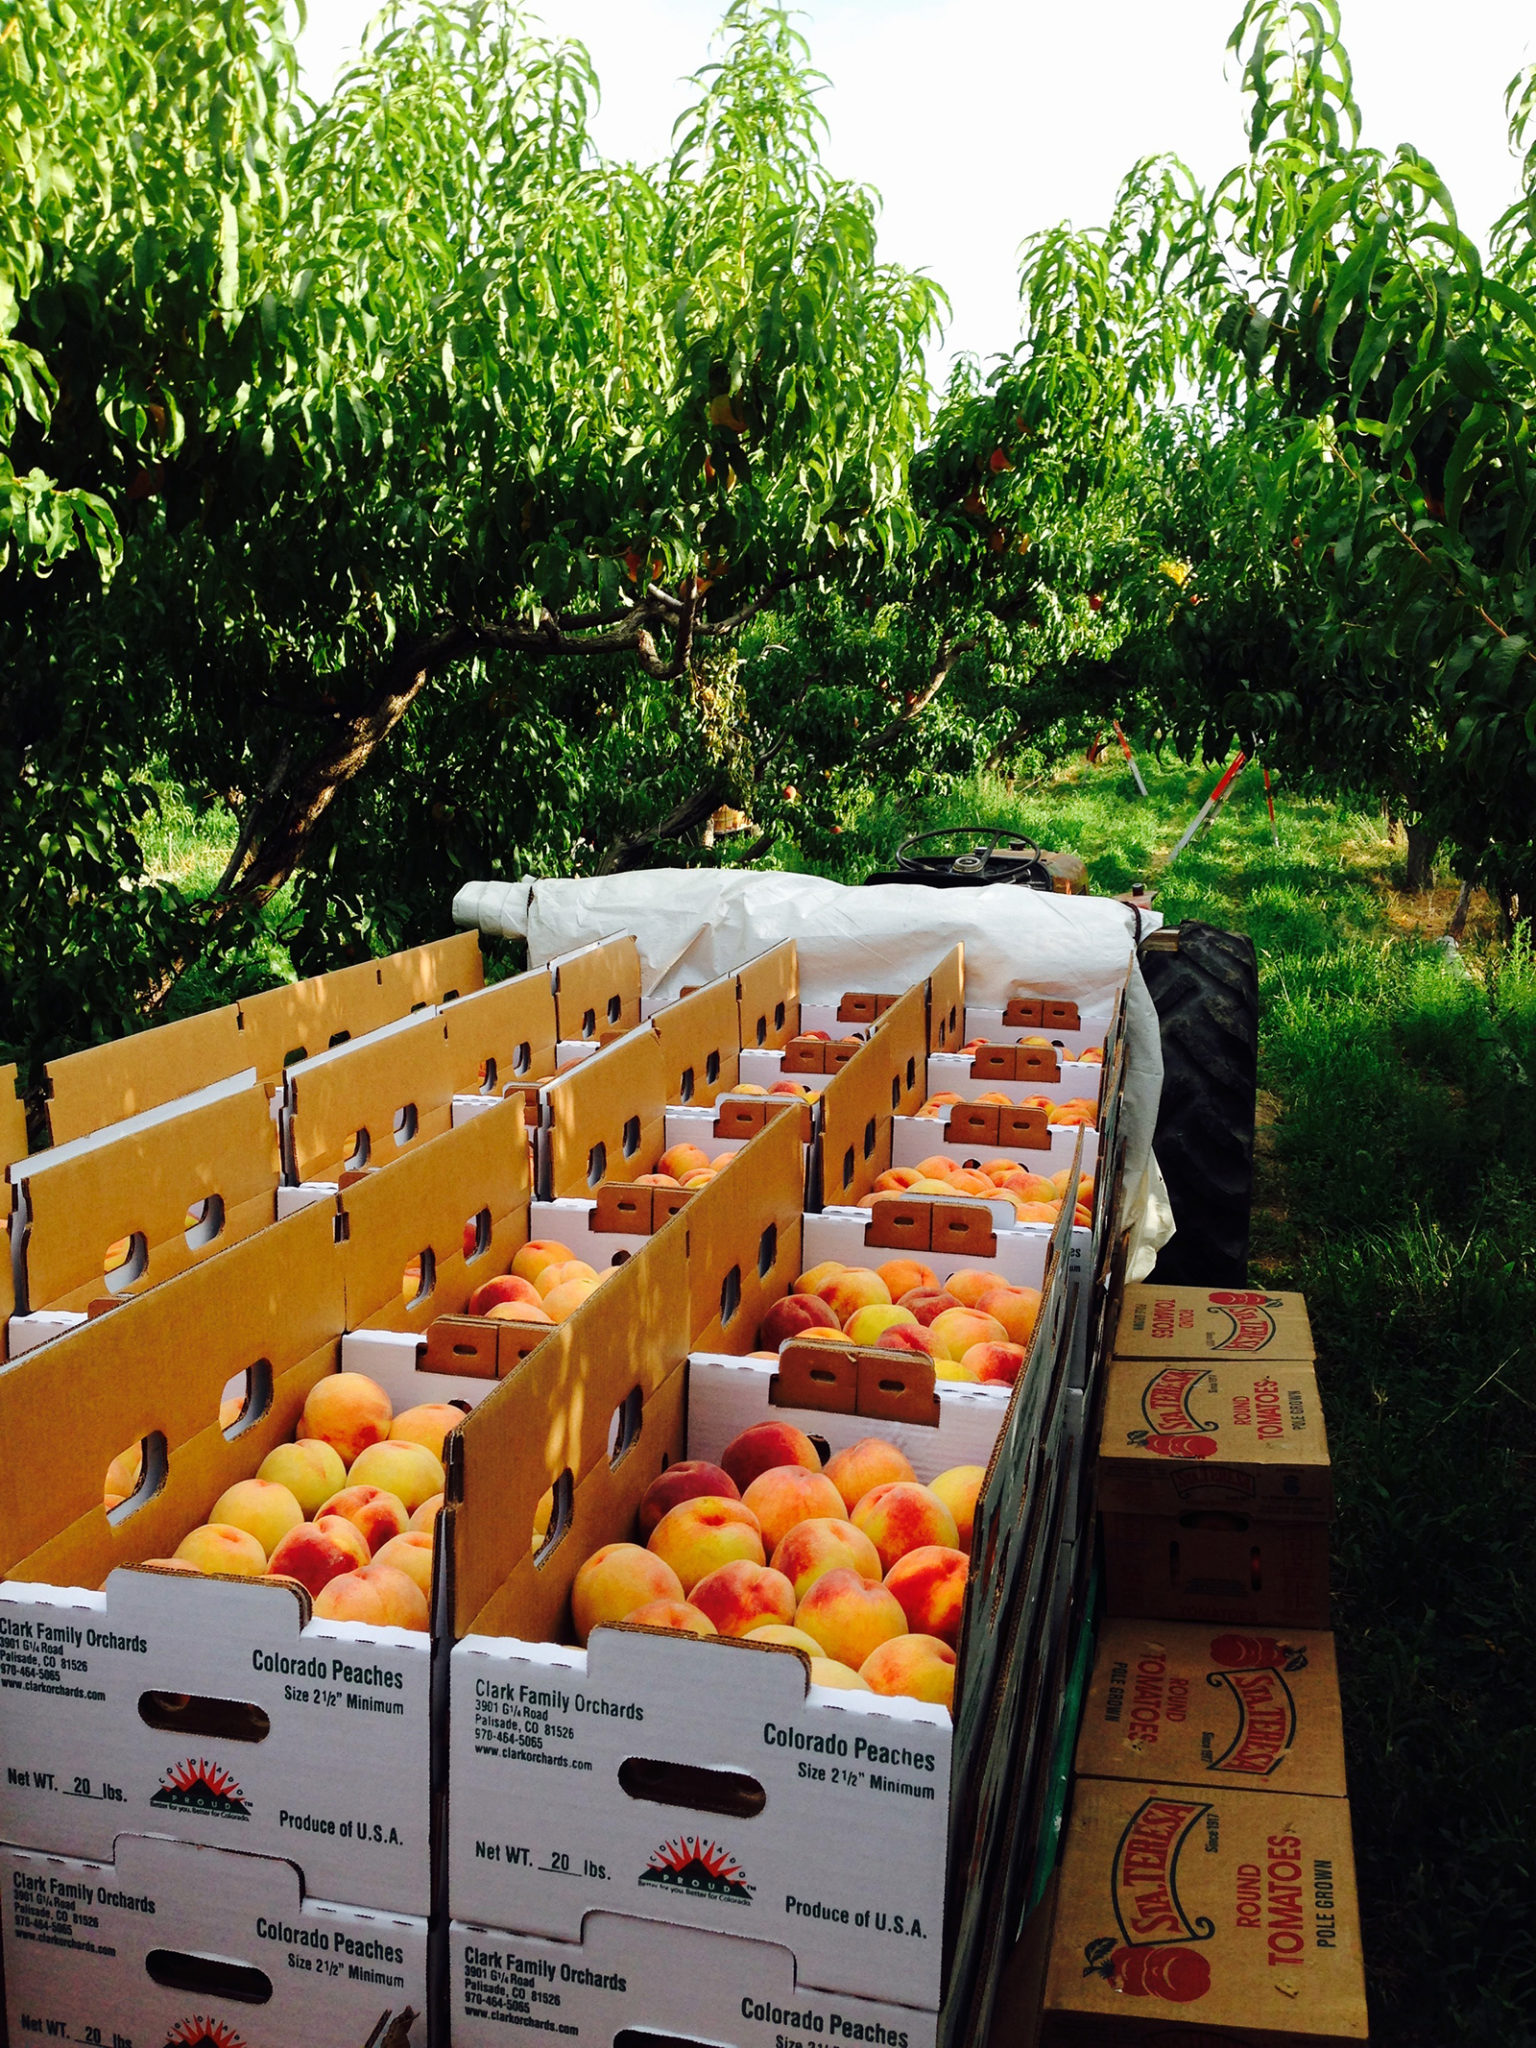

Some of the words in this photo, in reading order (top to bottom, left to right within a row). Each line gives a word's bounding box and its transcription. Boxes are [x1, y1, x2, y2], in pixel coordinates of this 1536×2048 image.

[1152, 1299, 1175, 1338] TOMATOES
[1151, 1371, 1202, 1409] TERESA
[1288, 1390, 1304, 1415] GROWN
[1232, 1395, 1251, 1426] ROUND
[1253, 1380, 1284, 1440] TOMATOES
[1291, 1415, 1306, 1430] POLE
[0, 1617, 33, 1638] Clark
[37, 1623, 82, 1648] Family
[87, 1629, 147, 1653] Orchards
[0, 1637, 20, 1649] 3901
[41, 1642, 64, 1655] Road
[0, 1649, 41, 1667] Palisade,
[44, 1656, 56, 1668] CO
[61, 1658, 88, 1672] 81526
[252, 1649, 327, 1679] Colorado
[332, 1659, 403, 1690] Peaches
[1111, 1662, 1128, 1686] POLE
[1, 1679, 106, 1701] www.clarkorchards.com
[284, 1685, 309, 1703] Size
[347, 1693, 404, 1715] Minimum
[475, 1678, 514, 1702] Clark
[519, 1685, 570, 1713] Family
[575, 1694, 644, 1721] Orchards
[1105, 1687, 1126, 1722] GROWN
[1128, 1653, 1166, 1744] TOMATOES
[1166, 1678, 1189, 1722] ROUND
[475, 1699, 498, 1713] 3901
[523, 1706, 549, 1722] Road
[475, 1713, 522, 1733] Palisade,
[524, 1721, 539, 1734] CO
[544, 1724, 574, 1740] 81526
[475, 1728, 543, 1749] 970-464-5065
[763, 1722, 848, 1757] Colorado
[854, 1737, 935, 1772] Peaches
[1221, 1706, 1286, 1772] TERESA
[475, 1744, 593, 1771] www.clarkorchards.com
[7, 1768, 31, 1787] Net
[33, 1771, 59, 1791] WT.
[73, 1777, 92, 1795] 20
[102, 1783, 128, 1803] lbs.
[798, 1762, 826, 1781] Size
[870, 1774, 935, 1800] Minimum
[172, 1794, 231, 1810] PROUD
[279, 1809, 335, 1835] Produce
[340, 1820, 353, 1838] of
[357, 1822, 404, 1846] U.S.A.
[1206, 1813, 1219, 1829] 1917
[1123, 1802, 1196, 1887] TERESA
[1205, 1831, 1218, 1853] Since
[475, 1840, 500, 1861] Net
[505, 1845, 533, 1867] WT.
[551, 1851, 570, 1871] 20
[584, 1859, 611, 1880] lbs.
[13, 1871, 47, 1893] Clark
[50, 1878, 94, 1905] Family
[97, 1887, 156, 1914] Orchards
[663, 1874, 731, 1893] PROUD
[1236, 1864, 1262, 1928] ROUND
[1267, 1835, 1304, 1966] TOMATOES
[1314, 1859, 1334, 1909] GROWN
[54, 1896, 76, 1912] Road
[56, 1910, 69, 1922] CO
[785, 1895, 849, 1924] Produce
[855, 1910, 870, 1928] of
[875, 1912, 927, 1939] U.S.A.
[256, 1917, 329, 1951] Colorado
[334, 1932, 404, 1964] Peaches
[1316, 1913, 1336, 1948] POLE
[288, 1952, 312, 1971] Size
[348, 1964, 405, 1989] Minimum
[464, 1946, 502, 1969] Clark
[506, 1953, 556, 1982] Family
[560, 1963, 627, 1992] Orchards
[465, 1965, 487, 1979] 3901
[510, 1973, 535, 1988] Road
[465, 1978, 509, 1998] Palisade,
[512, 1987, 526, 1999] CO
[531, 1990, 561, 2006] 81526
[465, 1991, 530, 2014] 970-464-5065
[21, 2013, 43, 2033] Net
[46, 2019, 71, 2039] WT.
[84, 2026, 101, 2044] 20
[465, 2005, 579, 2036] www.clarkorchards.com
[741, 1997, 824, 2033] Colorado
[830, 2013, 908, 2048] Peaches
